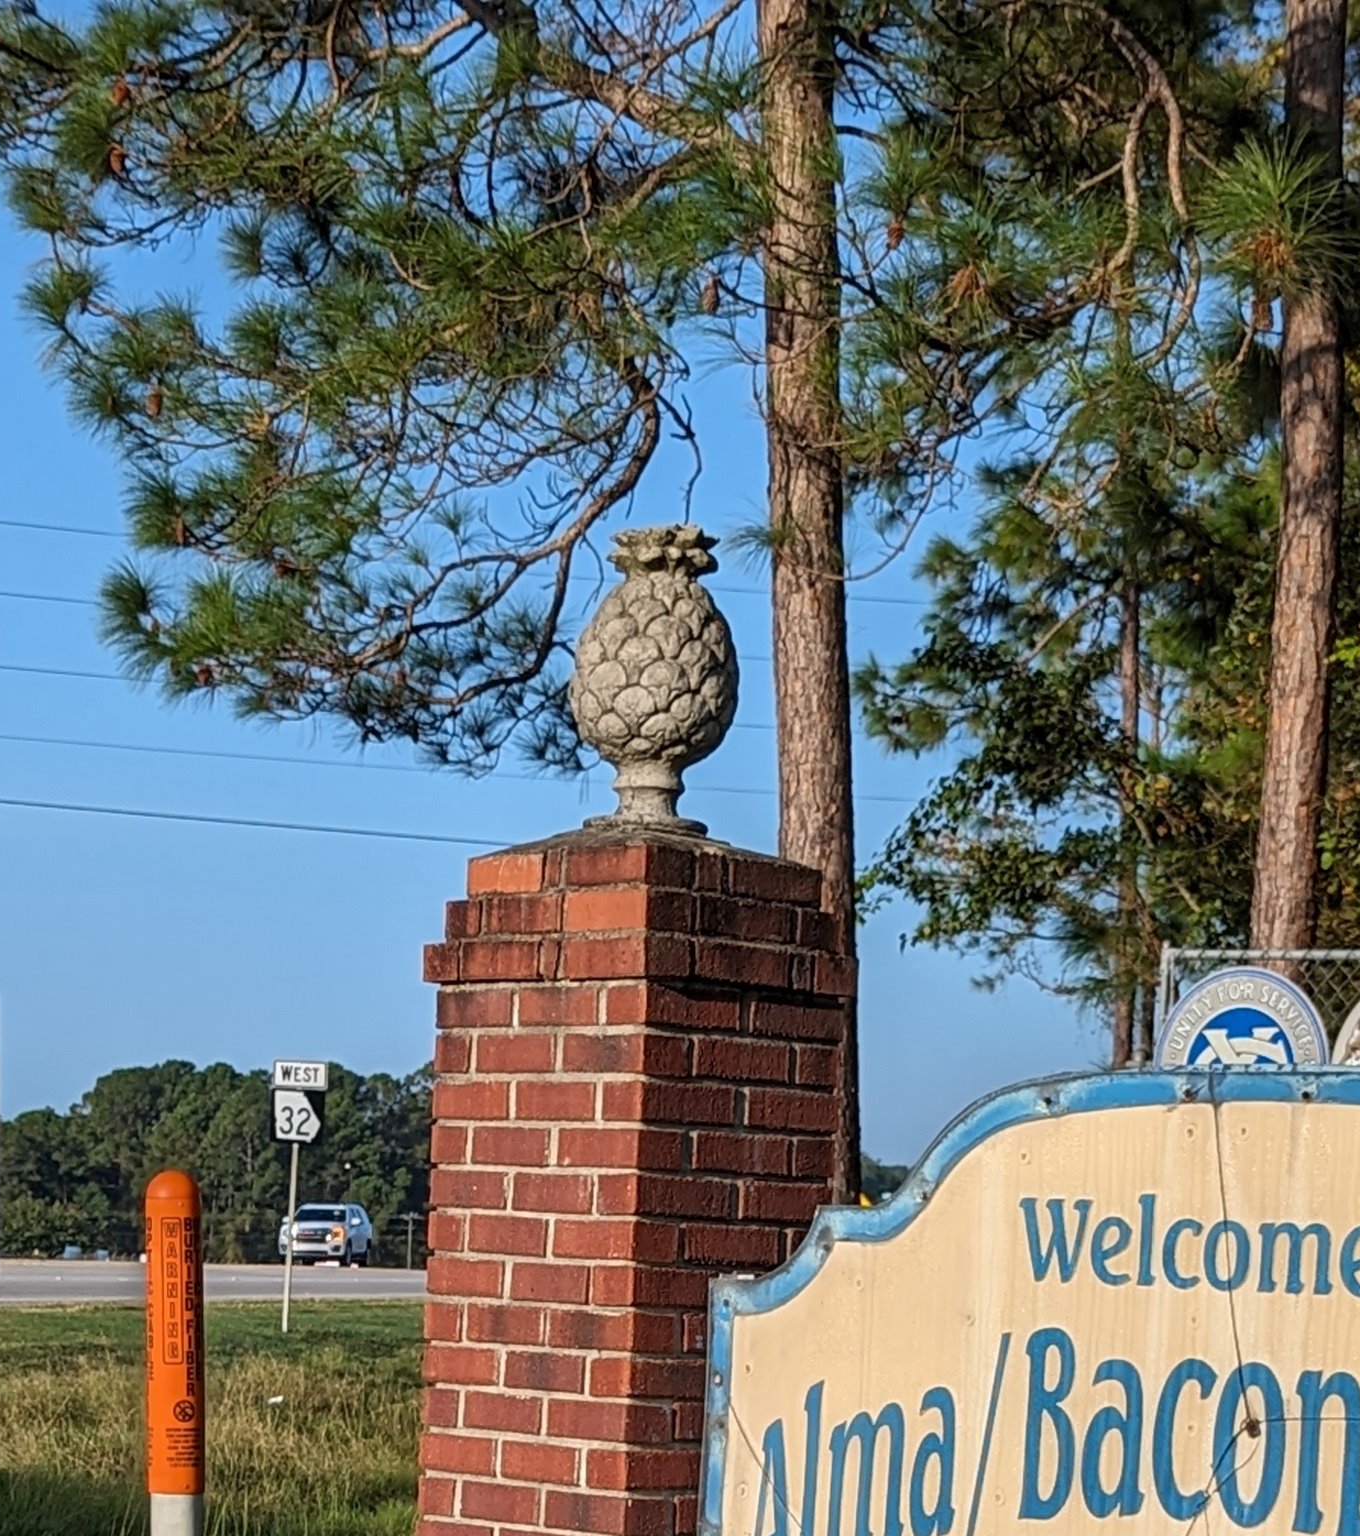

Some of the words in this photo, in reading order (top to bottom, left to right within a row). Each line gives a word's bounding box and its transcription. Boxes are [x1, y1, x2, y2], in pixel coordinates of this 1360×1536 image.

[1170, 997, 1212, 1050] UNITY
[1217, 982, 1254, 1002] FOR
[1260, 985, 1313, 1050] SERVICE
[281, 1065, 320, 1083] WEST
[279, 1106, 310, 1136] 32
[164, 1221, 180, 1359] WARNING
[184, 1217, 194, 1312] BURIED
[185, 1319, 196, 1397] FIBER
